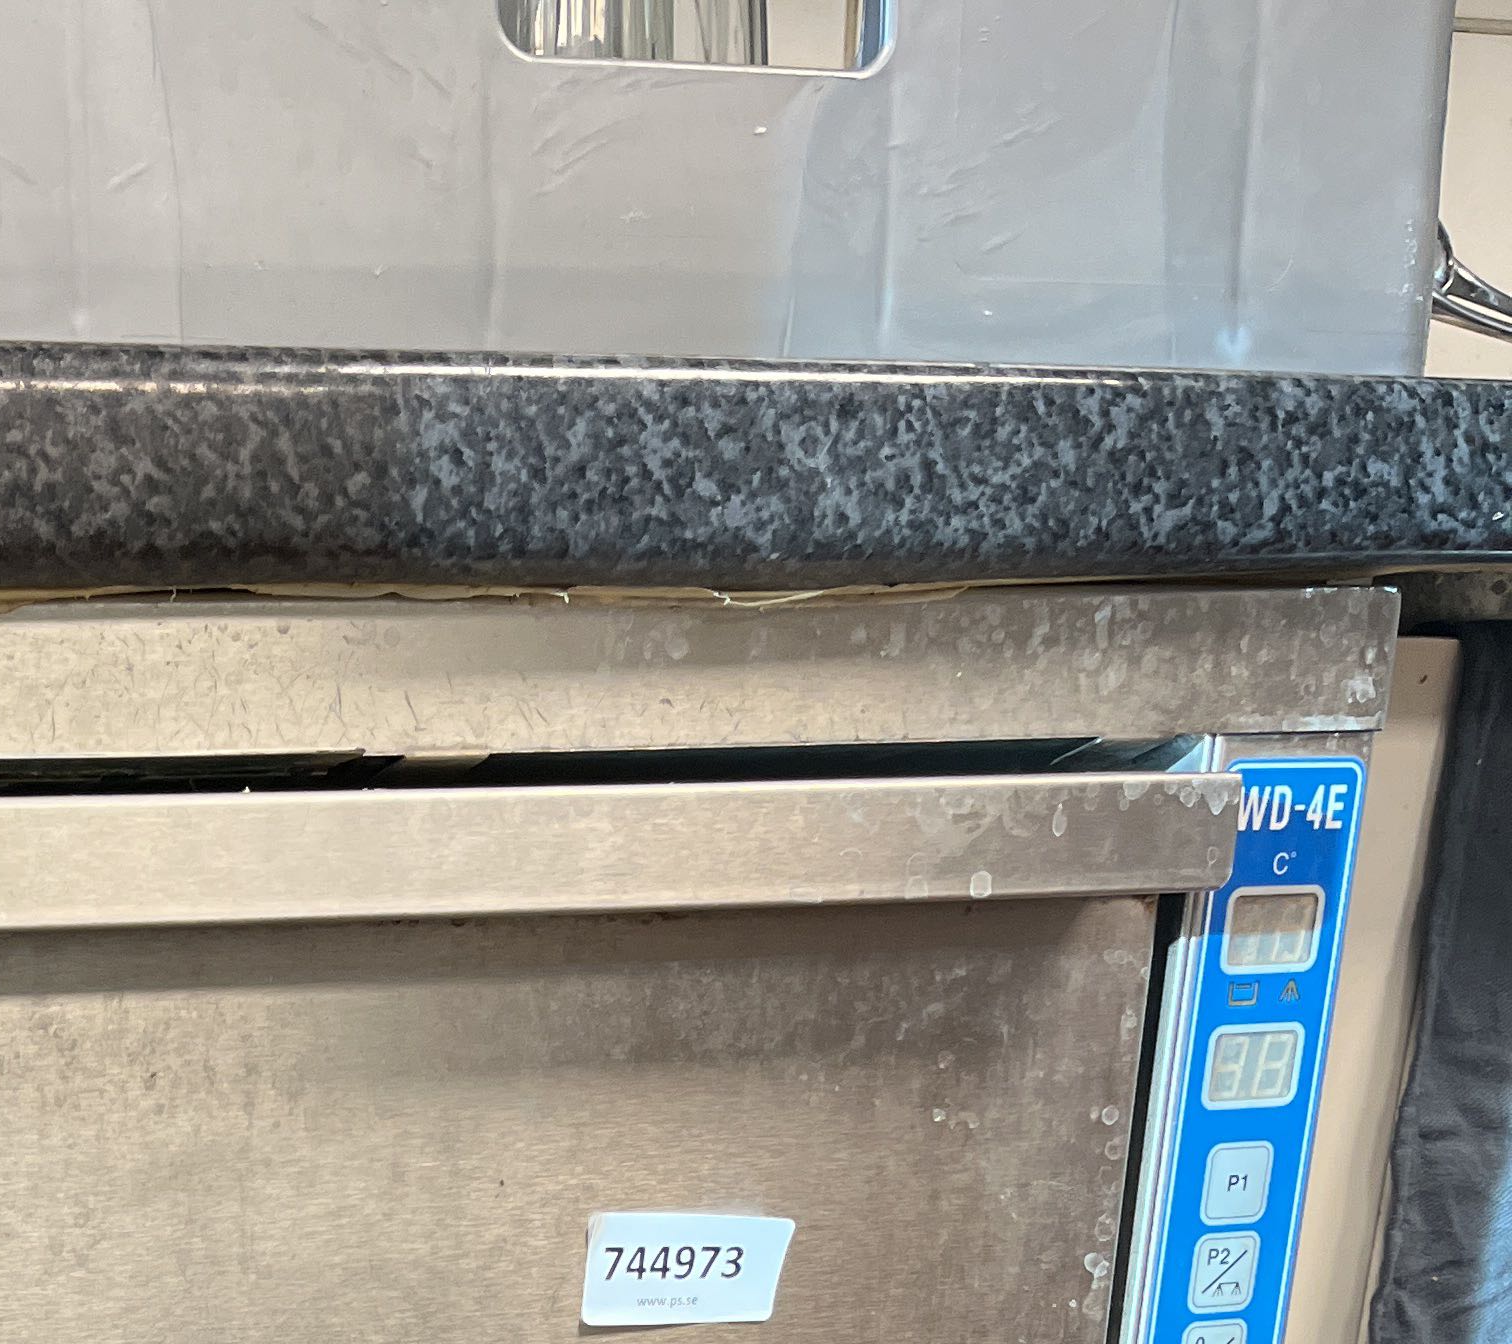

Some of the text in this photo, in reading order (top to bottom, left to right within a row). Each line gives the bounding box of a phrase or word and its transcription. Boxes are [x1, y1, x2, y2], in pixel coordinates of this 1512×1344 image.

[1237, 784, 1349, 831] WD-4E
[1226, 1174, 1249, 1192] P1
[604, 1246, 744, 1281] 744973
[1206, 1248, 1231, 1266] P2
[636, 1295, 699, 1309] www.ps.se
